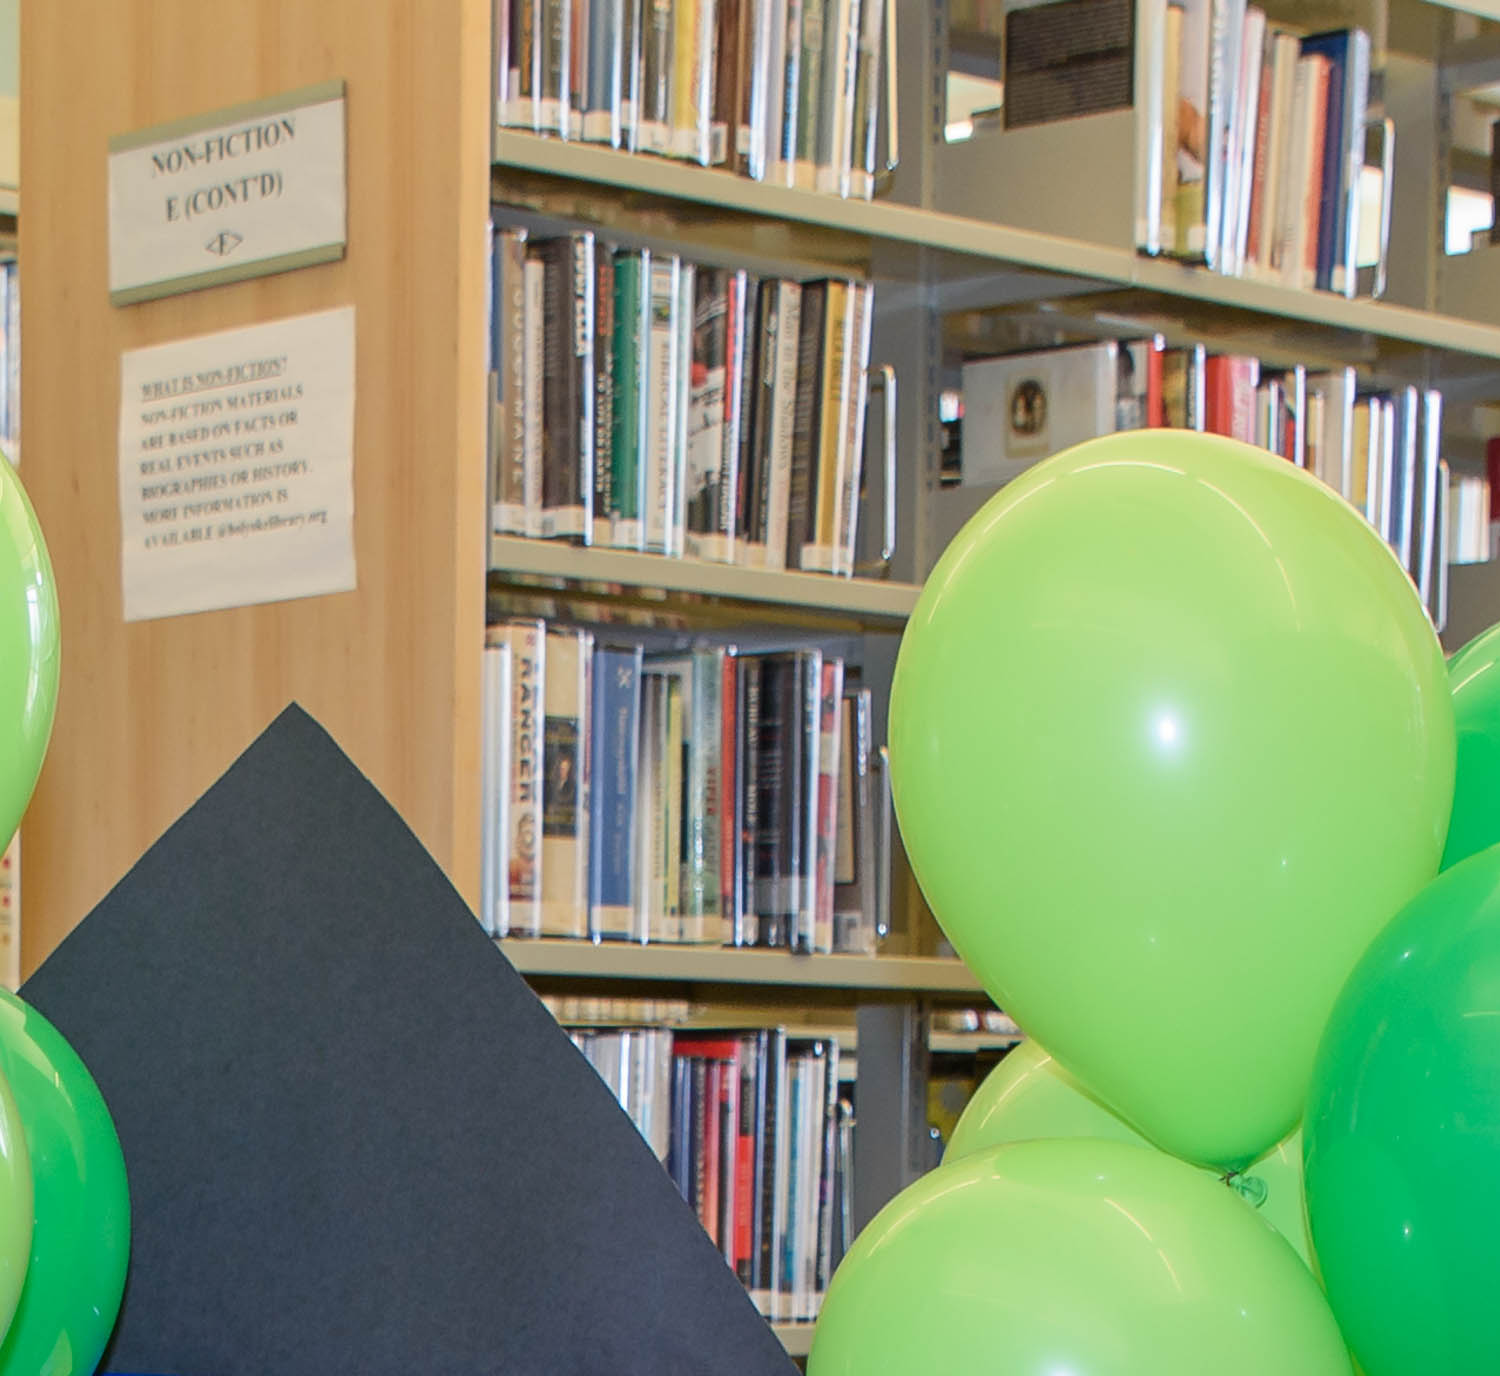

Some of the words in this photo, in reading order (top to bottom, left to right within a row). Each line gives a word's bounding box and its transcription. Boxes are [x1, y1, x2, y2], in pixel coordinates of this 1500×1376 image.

[152, 116, 296, 178] NON-FICTION
[166, 197, 179, 222] E
[185, 170, 283, 221] (CONT'D)
